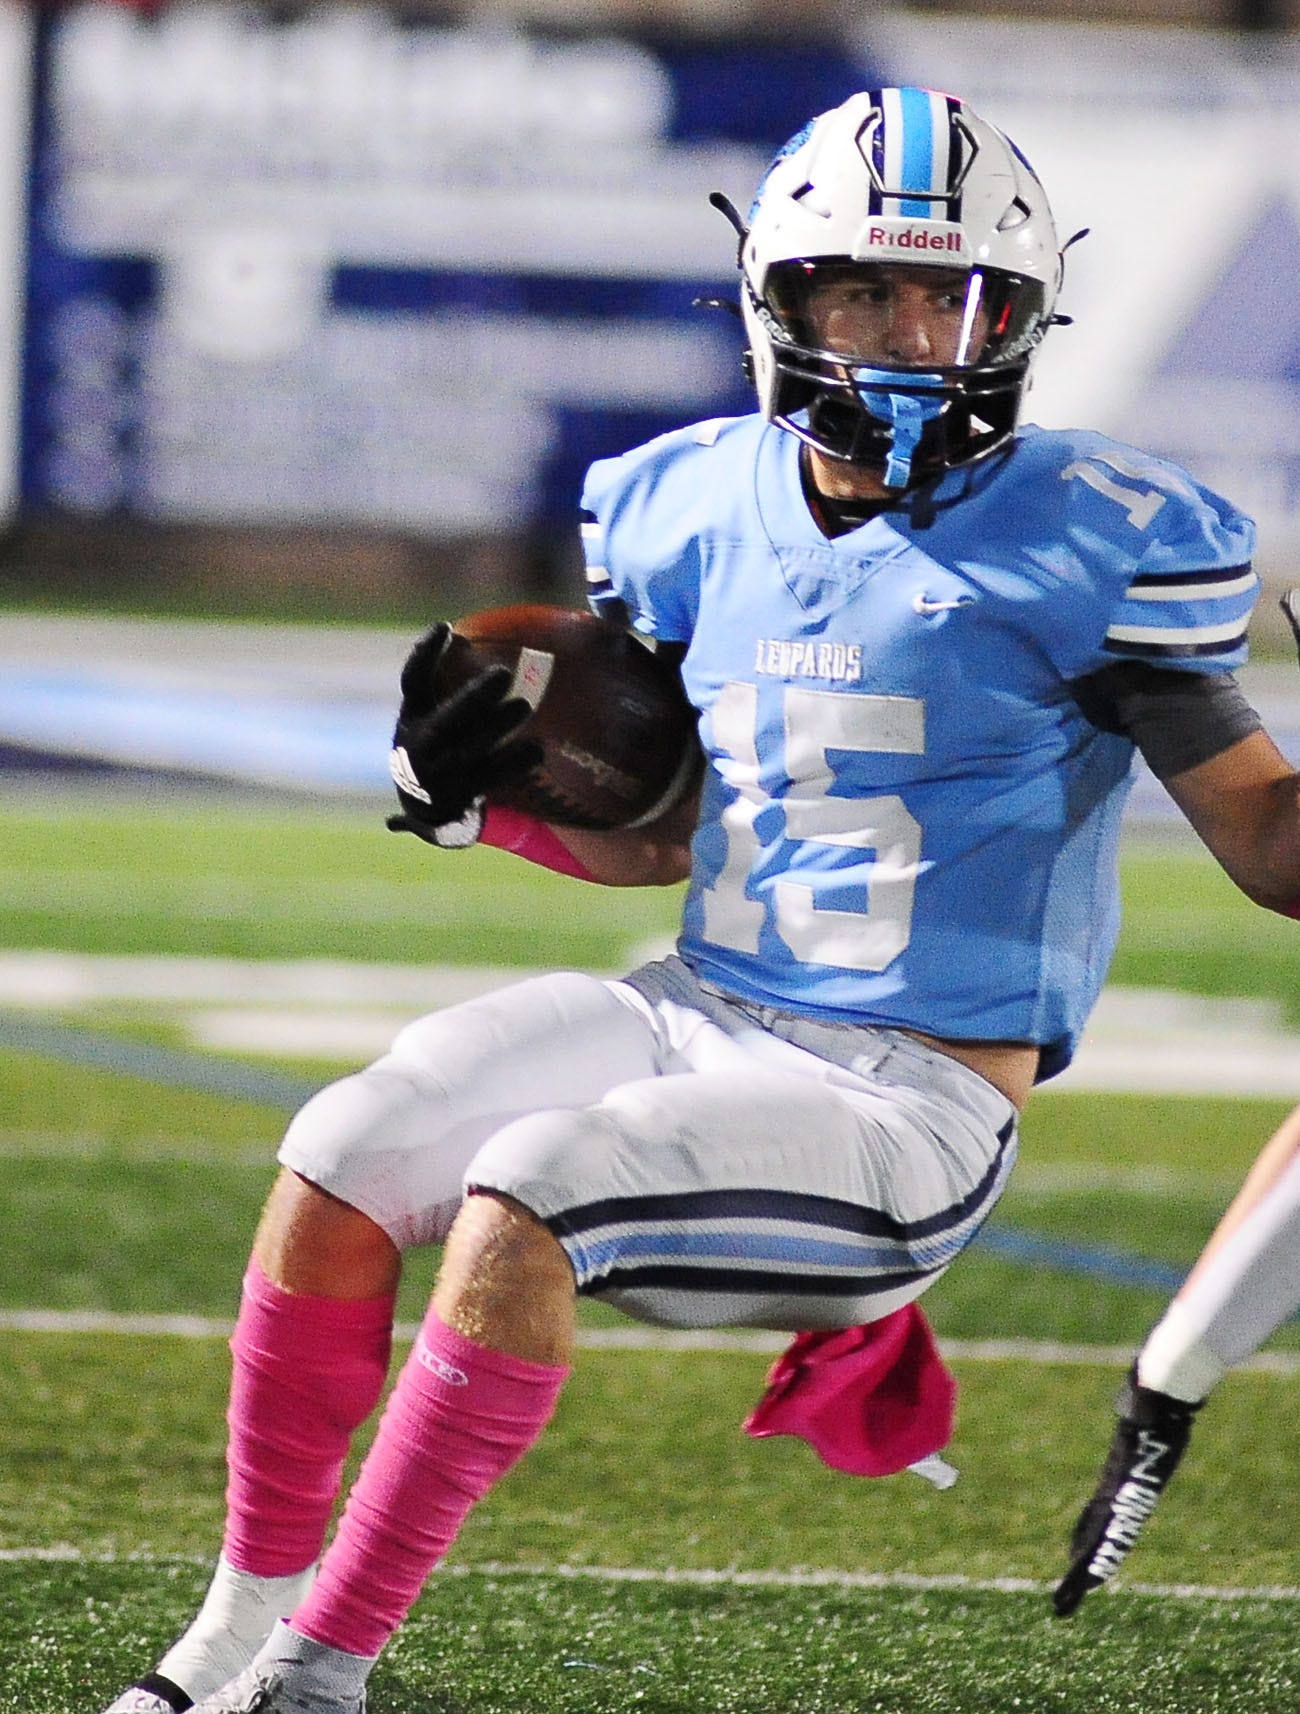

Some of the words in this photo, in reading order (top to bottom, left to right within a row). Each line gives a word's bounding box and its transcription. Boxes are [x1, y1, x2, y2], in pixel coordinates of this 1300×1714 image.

[869, 227, 962, 252] Riddell
[756, 639, 862, 682] LEOPARDS
[702, 681, 926, 972] 15
